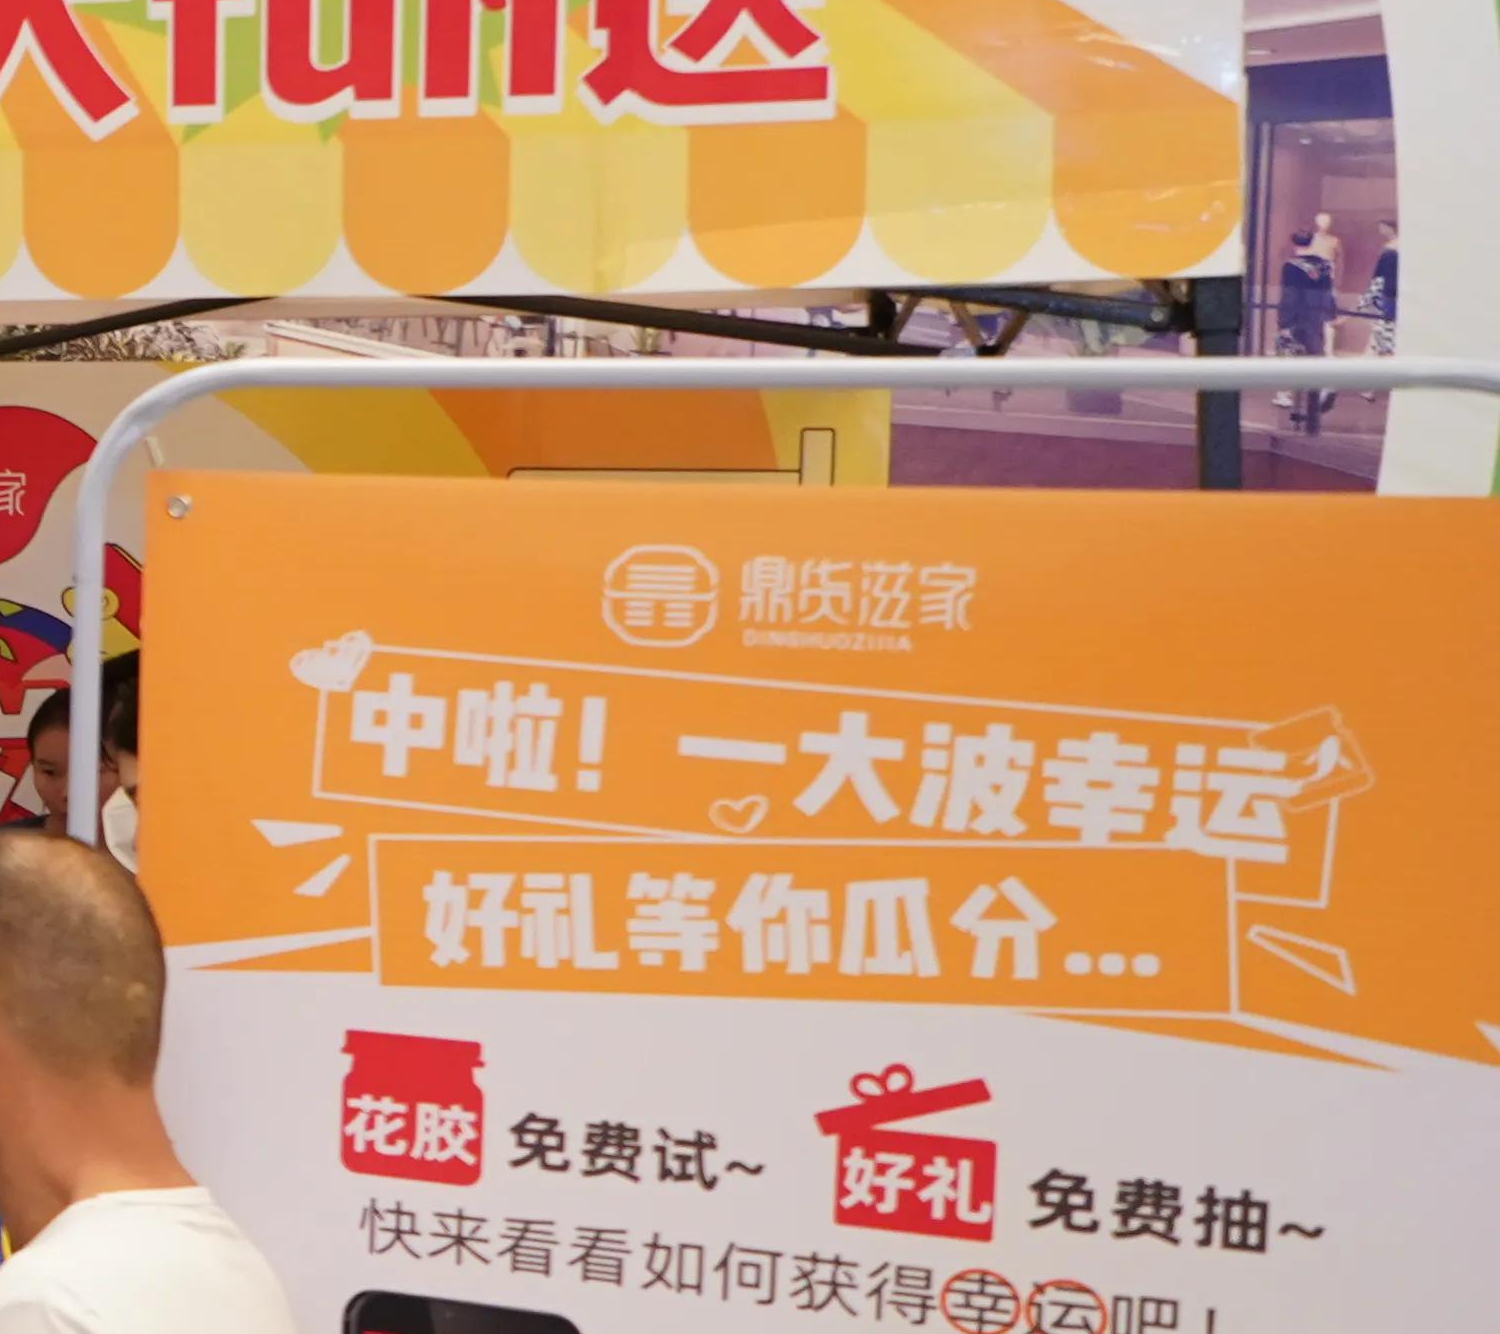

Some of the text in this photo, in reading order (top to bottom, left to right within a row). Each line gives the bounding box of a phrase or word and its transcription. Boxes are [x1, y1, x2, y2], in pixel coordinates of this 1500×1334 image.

[739, 554, 979, 631] 鼎货滋家
[343, 1093, 479, 1167] 花胶
[837, 1152, 995, 1228] 好礼
